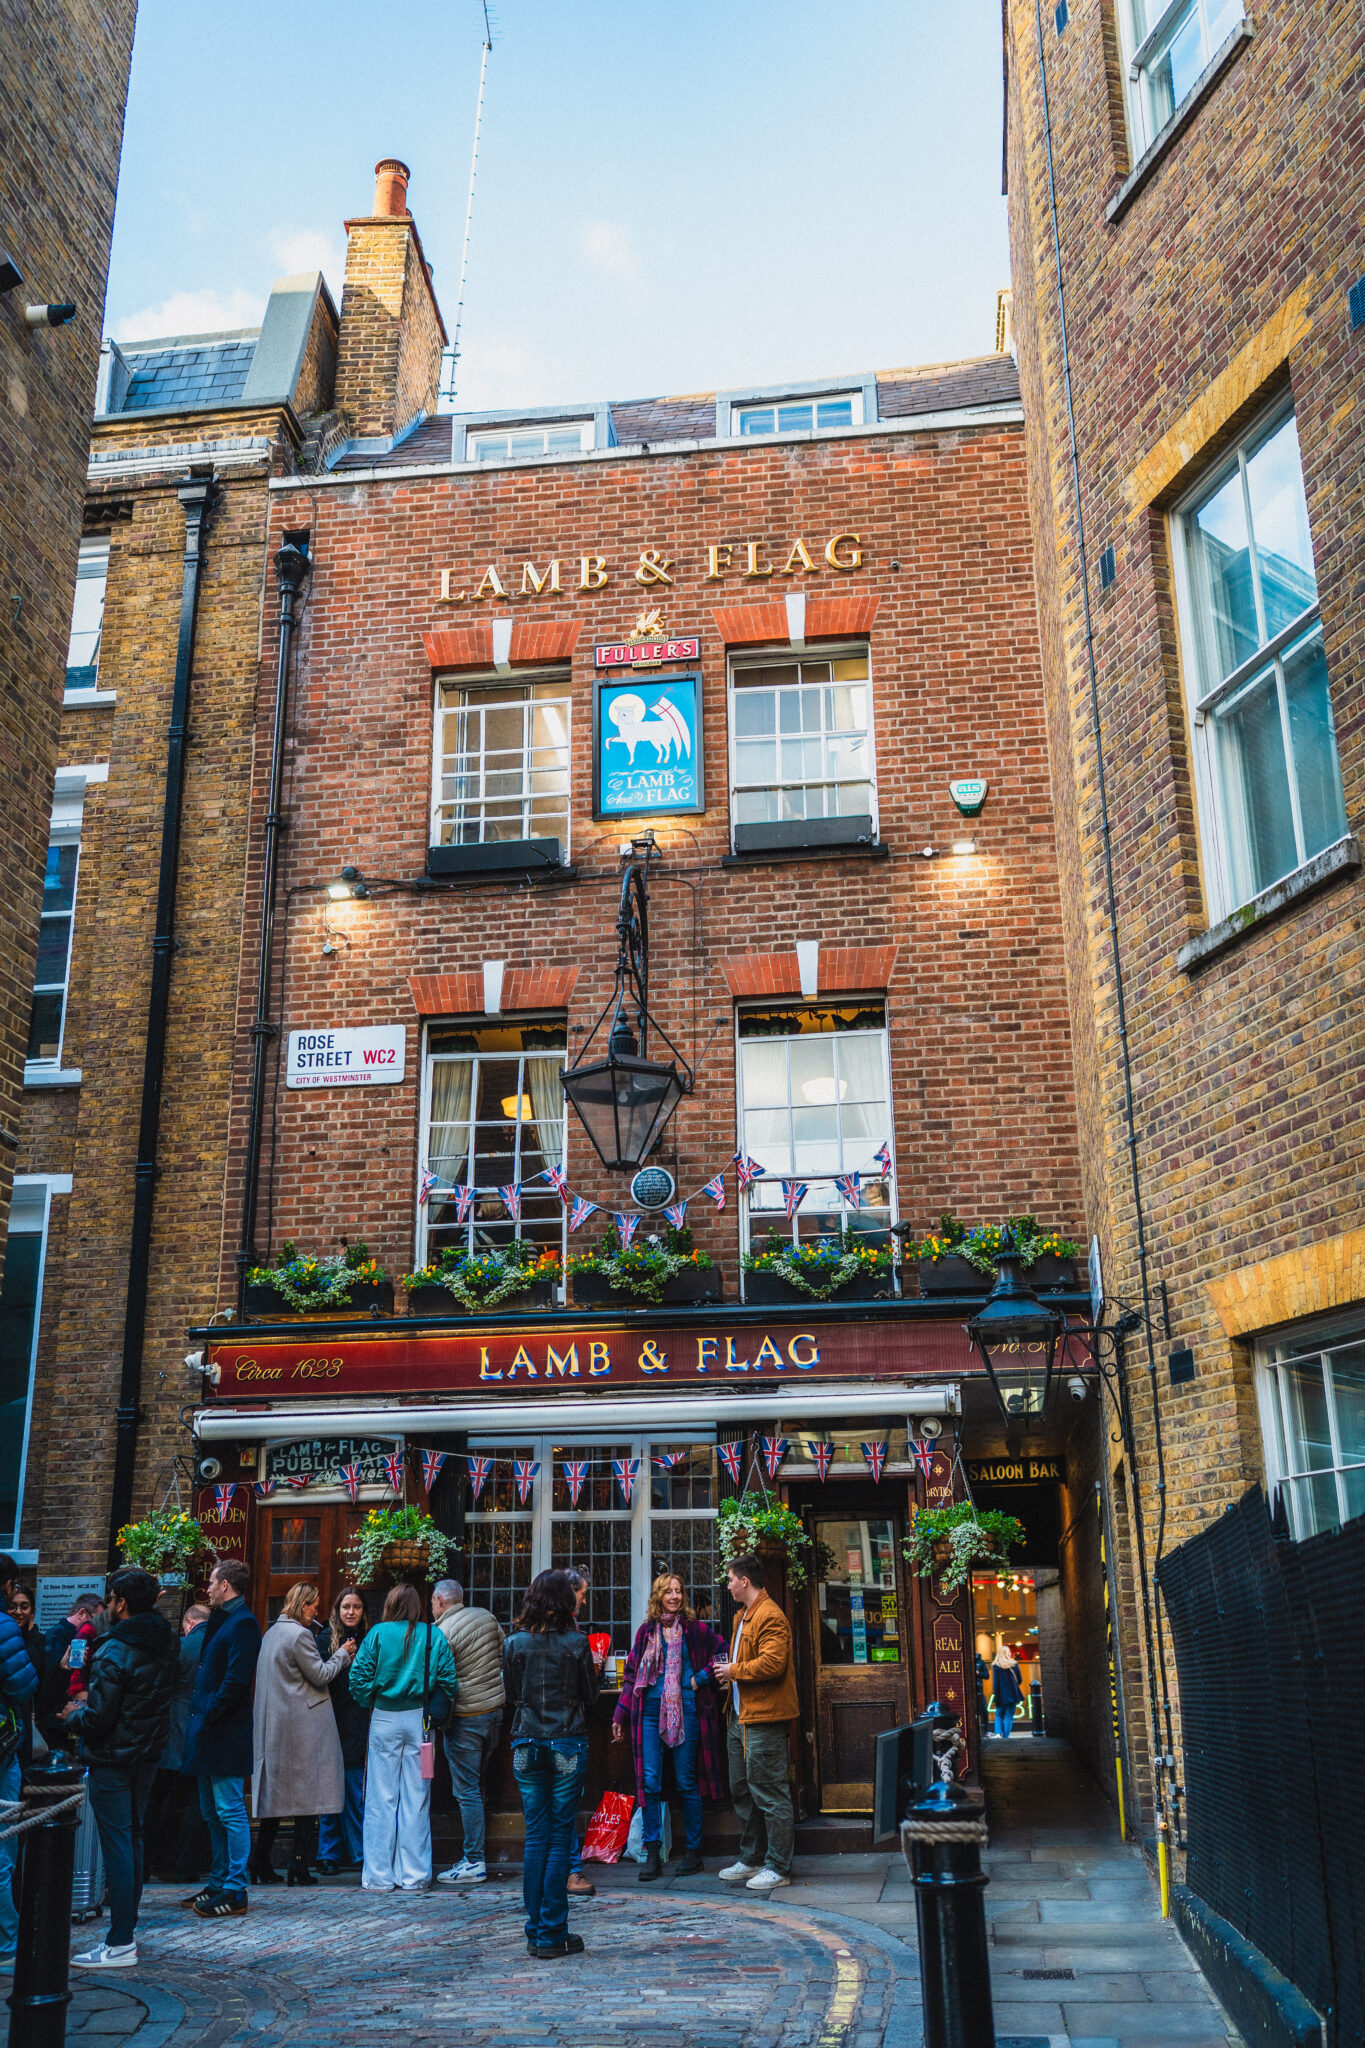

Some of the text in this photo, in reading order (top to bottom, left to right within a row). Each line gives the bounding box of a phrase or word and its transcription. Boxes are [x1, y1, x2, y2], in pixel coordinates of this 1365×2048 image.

[436, 534, 864, 602] LAMB & FLAG
[601, 642, 692, 663] FULLER'S
[627, 774, 675, 789] LAMB
[647, 787, 690, 802] FLAG
[298, 1035, 335, 1050] ROSE
[297, 1049, 396, 1068] STREET WC2
[323, 1074, 372, 1083] WESTMINSTER
[479, 1334, 820, 1380] LAMB & FLAG
[235, 1355, 343, 1381] Circa 1623
[280, 1440, 380, 1457] LAMB & FLAG
[272, 1456, 340, 1472] PUBLIC
[969, 1461, 1060, 1480] SALOON BAR
[205, 1535, 242, 1550] OOM
[882, 1599, 896, 1610] 50
[935, 1637, 961, 1651] REAL
[939, 1661, 960, 1672] ALE
